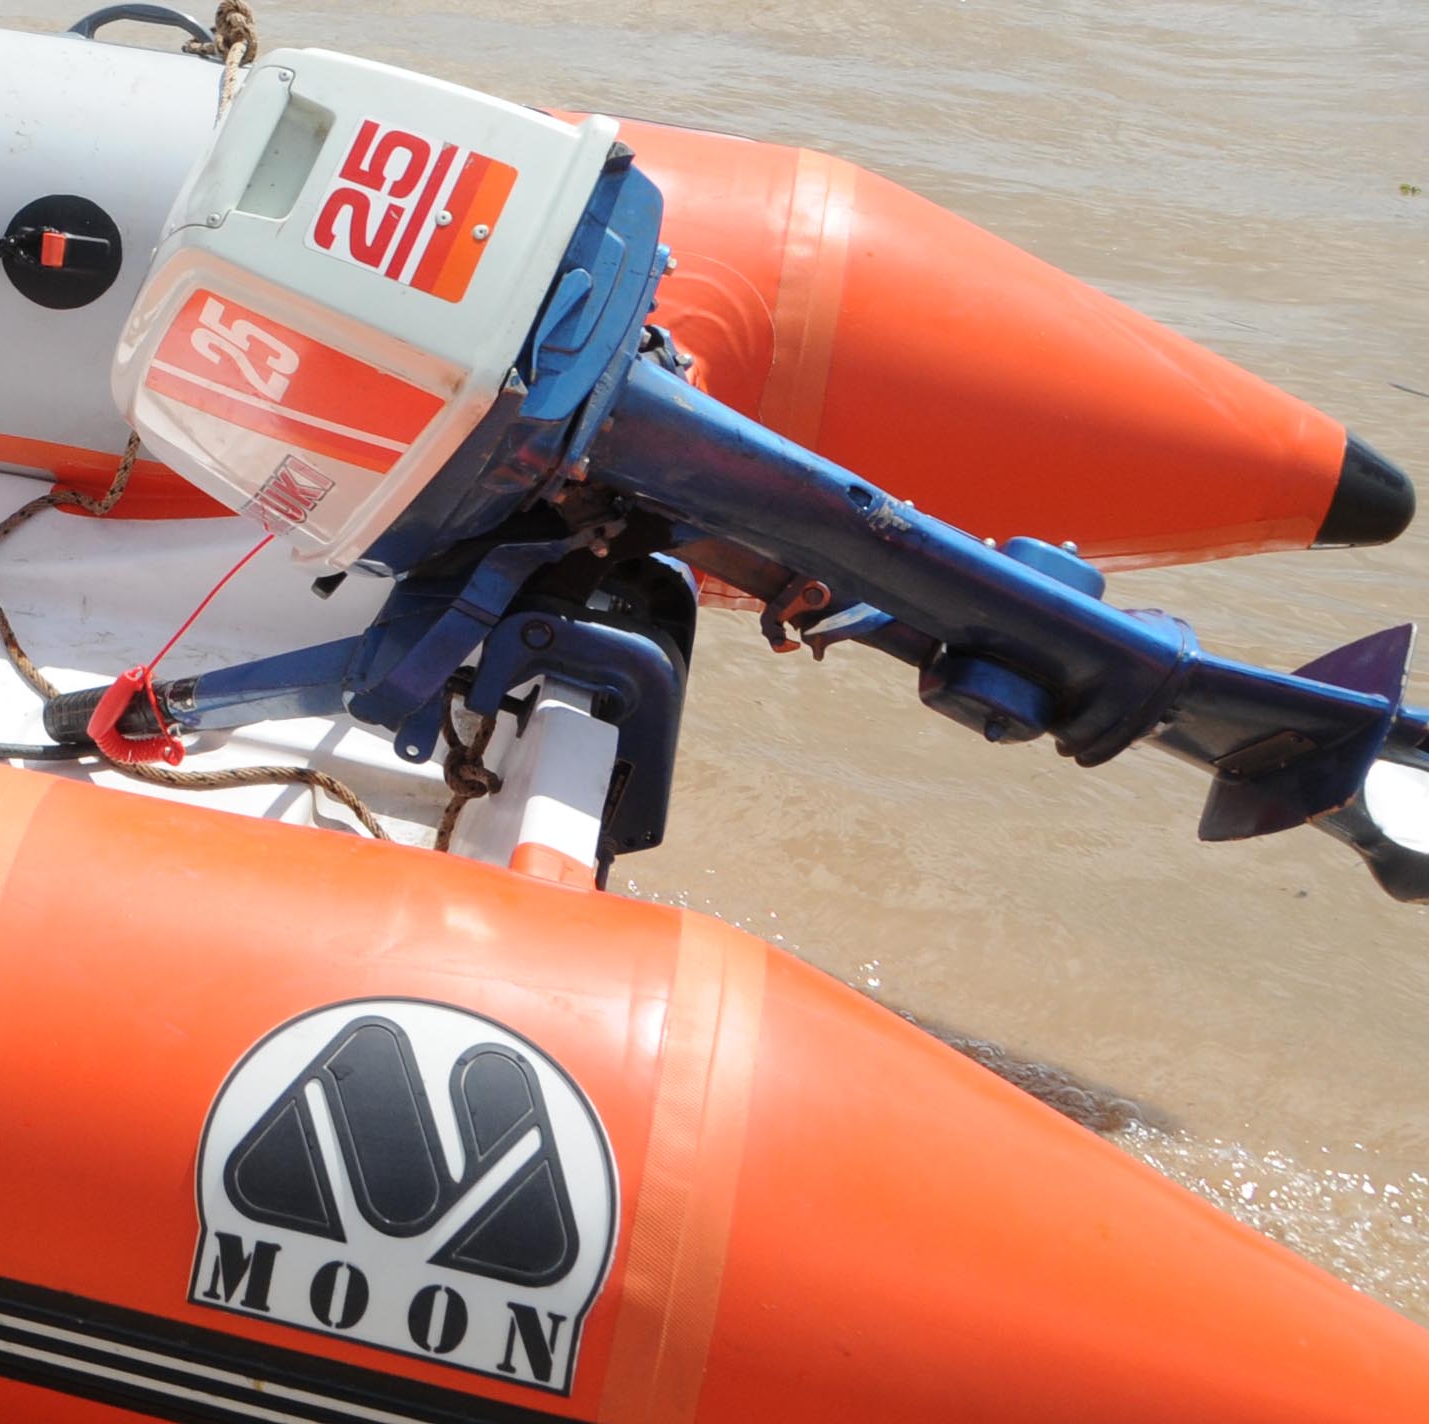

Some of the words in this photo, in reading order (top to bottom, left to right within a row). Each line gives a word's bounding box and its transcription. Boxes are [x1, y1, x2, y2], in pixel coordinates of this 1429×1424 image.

[313, 120, 431, 268] 25
[190, 297, 300, 403] 25
[202, 1231, 567, 1382] MOON
